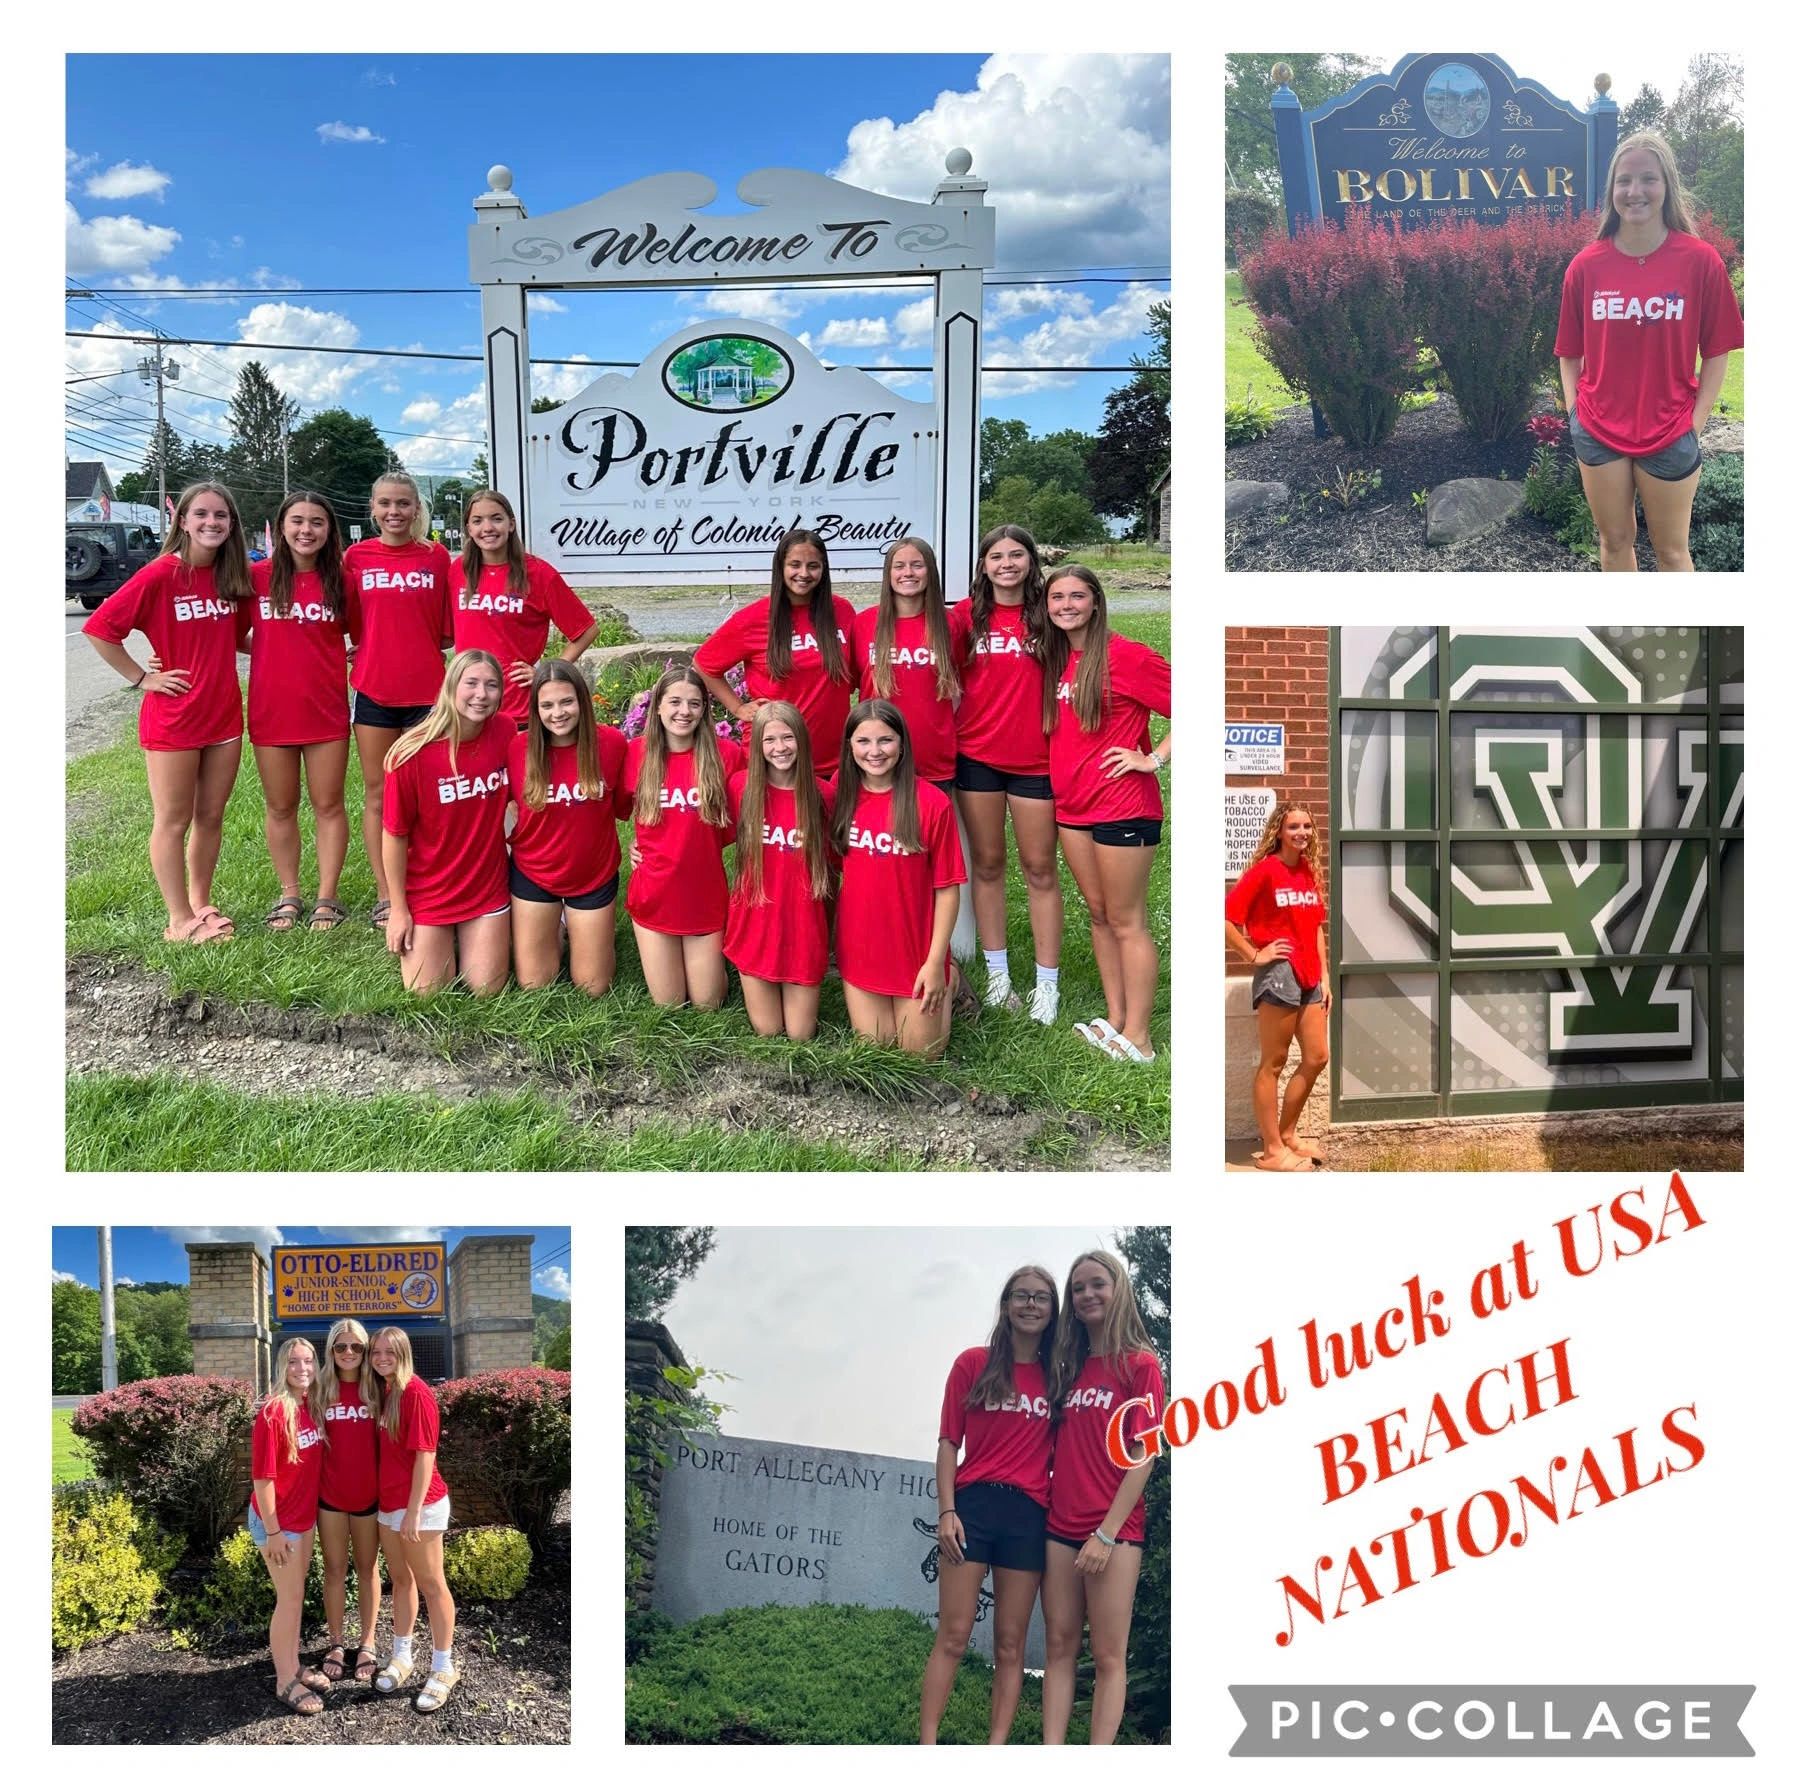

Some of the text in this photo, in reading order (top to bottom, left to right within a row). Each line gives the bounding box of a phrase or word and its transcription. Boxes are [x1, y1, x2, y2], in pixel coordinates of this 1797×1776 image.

[1389, 137, 1528, 160] Welcome to
[1332, 166, 1577, 203] BOLIVAR
[1376, 209, 1403, 219] LAND
[1408, 208, 1422, 218] OF
[1428, 207, 1447, 217] THE
[1482, 205, 1500, 216] AND
[1505, 205, 1523, 215] THE
[574, 220, 893, 268] Welcome To
[1592, 296, 1684, 320] BEACH
[561, 406, 901, 491] Portville
[633, 496, 824, 510] NEW YORK
[550, 514, 912, 555] Village of Colonial Beauty
[362, 571, 435, 591] BEACH
[1225, 795, 1270, 805] HE USE OF
[1225, 806, 1266, 816] TOBACCO
[1225, 817, 1268, 827] RODUCTS
[1229, 851, 1239, 860] IS
[281, 1252, 439, 1275] OTTO-ELDRED
[294, 1275, 387, 1290] JUNIOR-SENIOR
[298, 1289, 384, 1302] HIGH SCHOOL
[318, 1303, 330, 1311] OF
[334, 1303, 351, 1311] THE
[677, 1445, 742, 1473] PORT
[753, 1456, 887, 1492] ALLEGANY
[713, 1517, 843, 1547] HOME OF THE
[725, 1549, 825, 1581] GATORS
